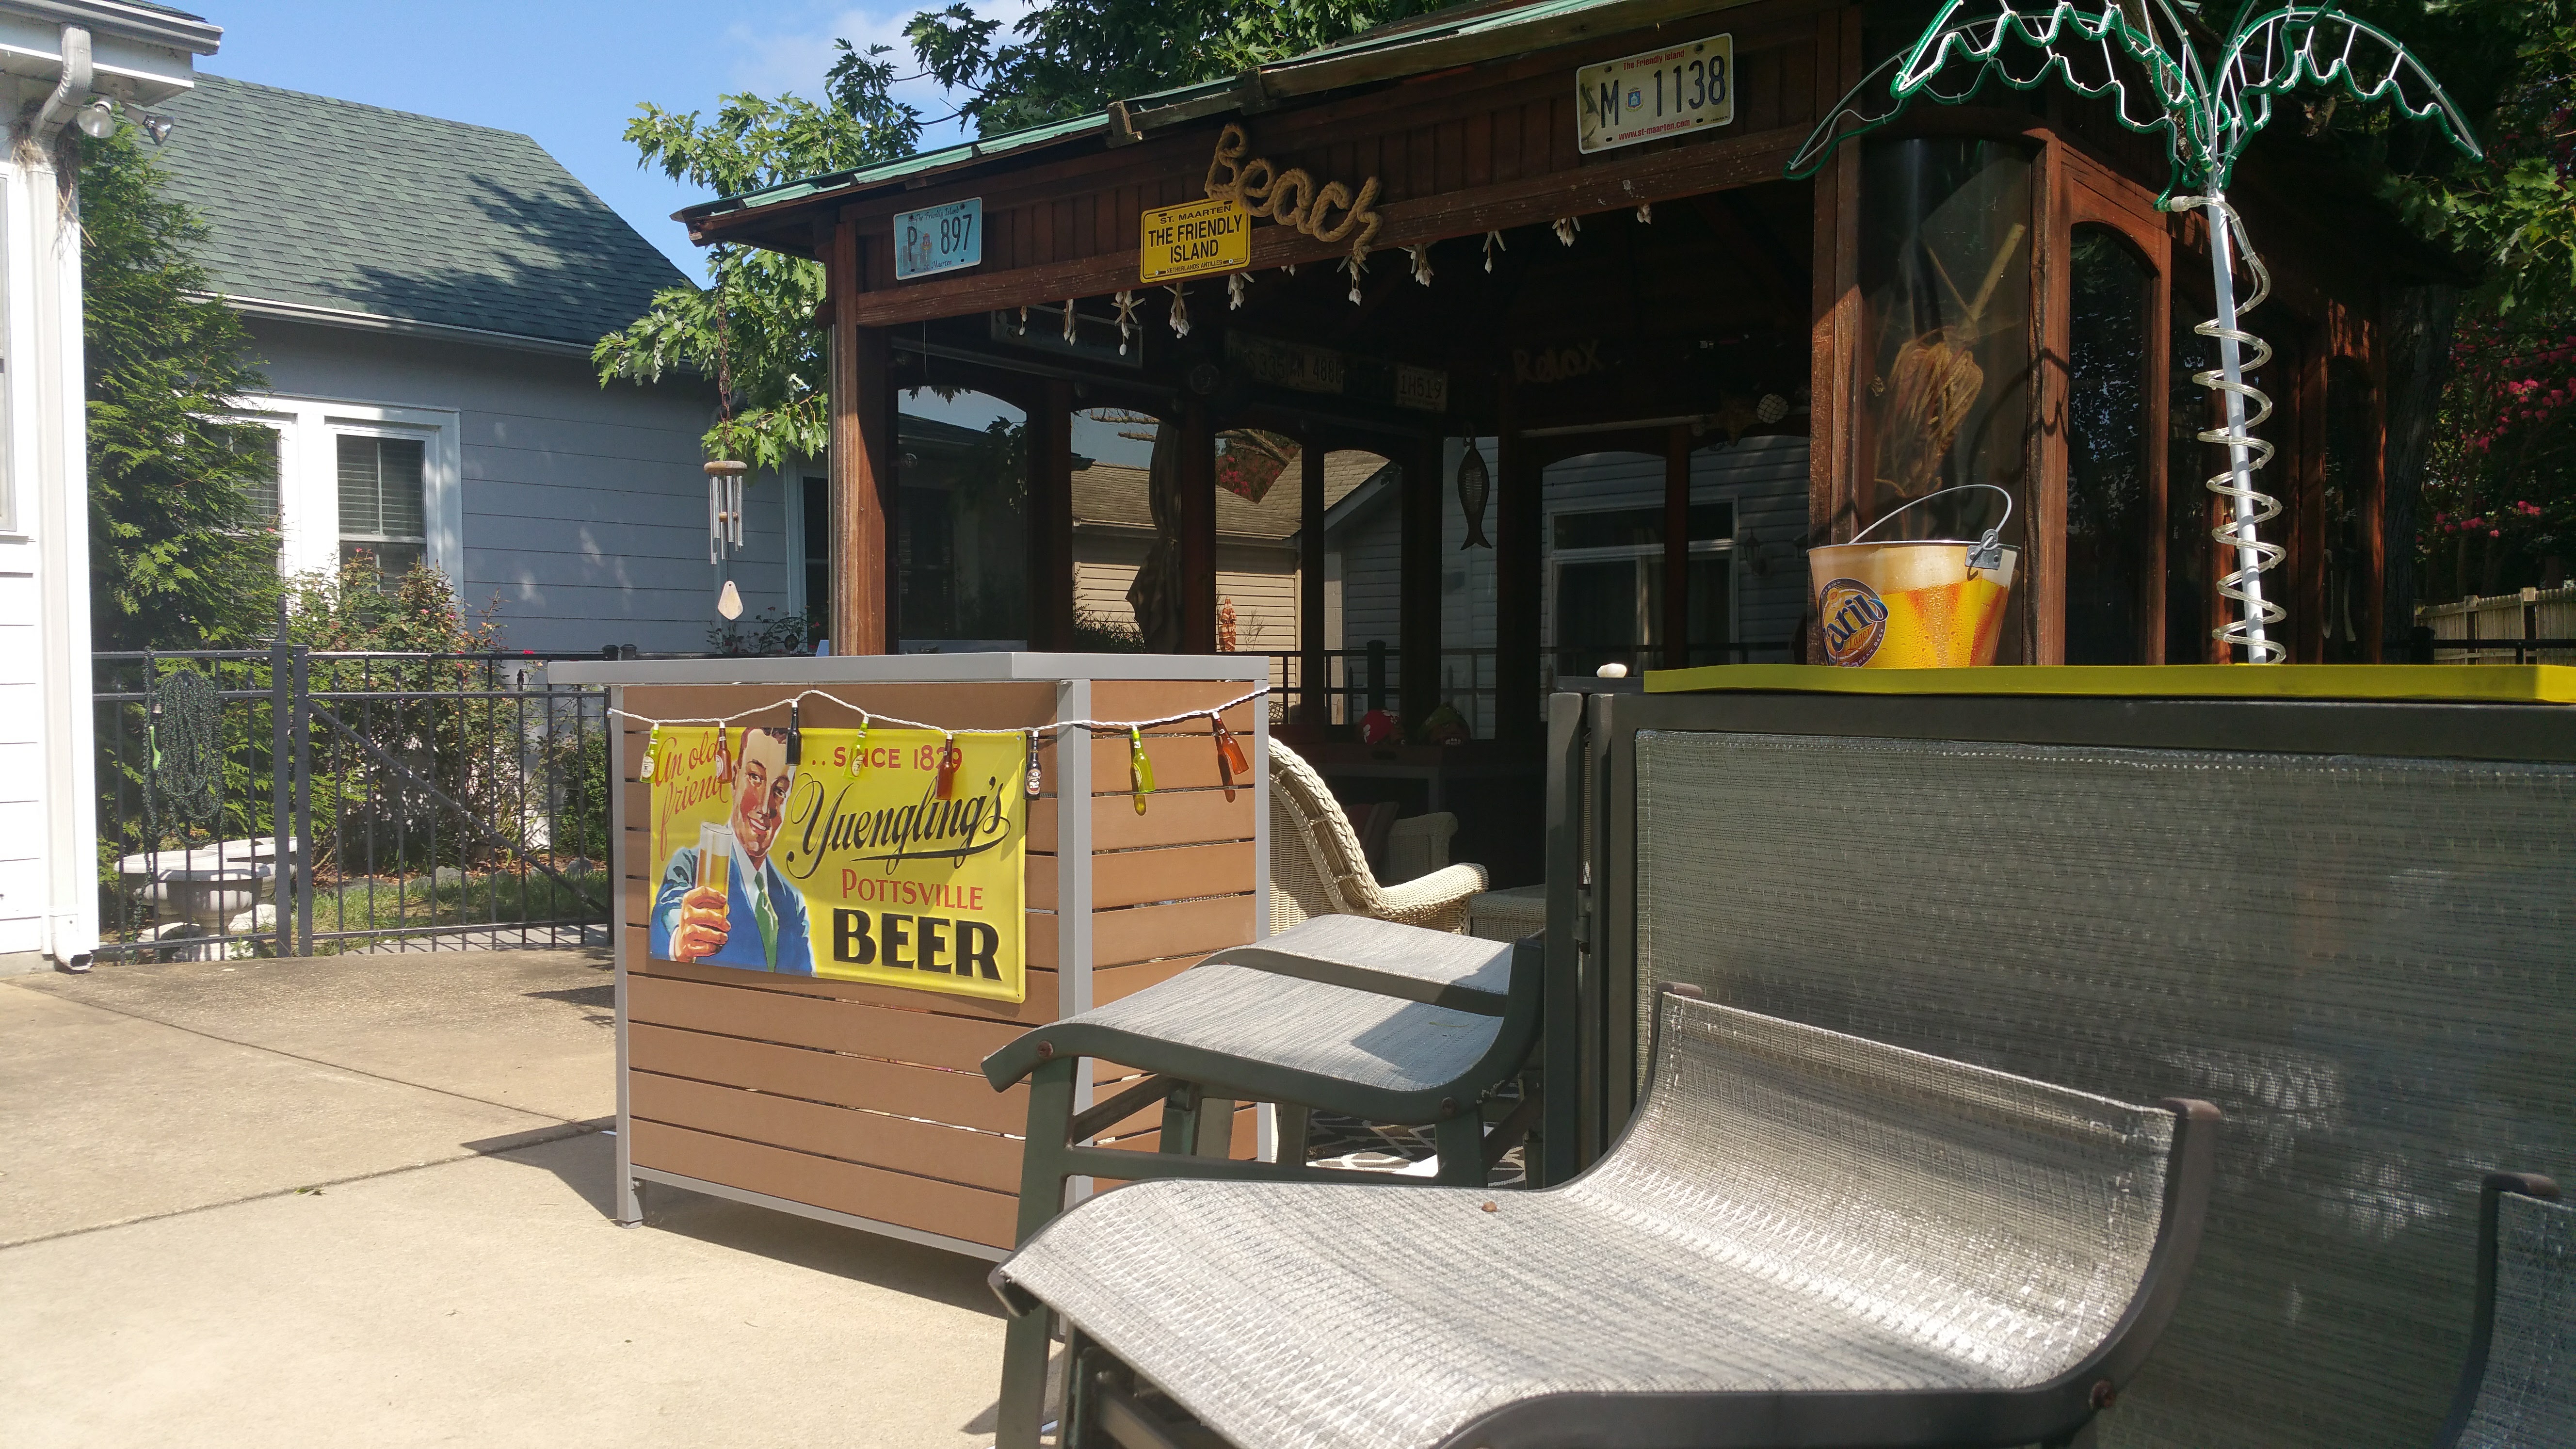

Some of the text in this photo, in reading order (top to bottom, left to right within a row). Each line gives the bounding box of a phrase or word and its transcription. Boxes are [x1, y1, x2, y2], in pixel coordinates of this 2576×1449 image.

[1623, 49, 1685, 71] The Friendly Island
[1601, 55, 1725, 129] M 1138
[1618, 118, 1690, 141] www.st-maarten.com
[925, 209, 944, 220] Friendly
[945, 206, 959, 216] Island
[1160, 205, 1231, 225] ST. MAARTEN
[907, 214, 972, 261] P 897
[1148, 214, 1242, 247] THE FRIENDLY
[1170, 239, 1219, 264] ISLAND
[932, 260, 952, 269] Maarten
[1166, 259, 1223, 274] NETHERLANDS ANTILLES
[1846, 628, 1870, 656] Lager
[1874, 628, 1884, 647] BEER
[655, 731, 720, 787] An old
[842, 869, 983, 911] POTTSVILLE
[833, 908, 1002, 982] BEER
